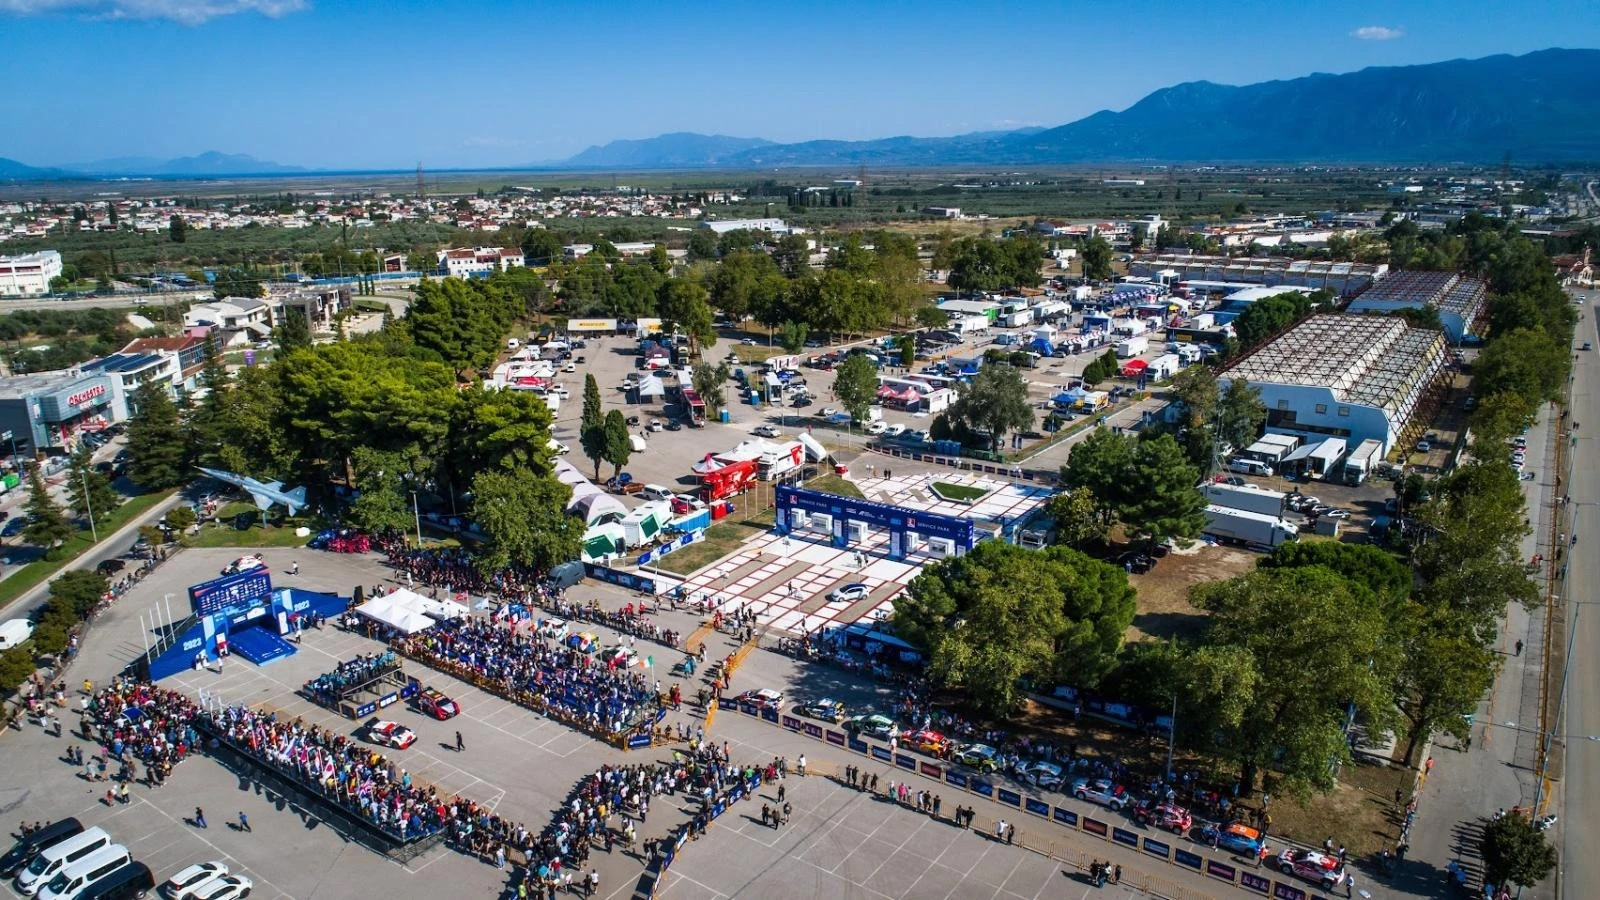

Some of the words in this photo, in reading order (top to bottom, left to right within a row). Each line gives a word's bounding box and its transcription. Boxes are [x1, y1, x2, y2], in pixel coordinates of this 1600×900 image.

[67, 384, 105, 406] ORCHESTRA
[917, 522, 936, 530] SERVICE
[294, 600, 310, 611] 2023
[183, 637, 202, 651] 2023
